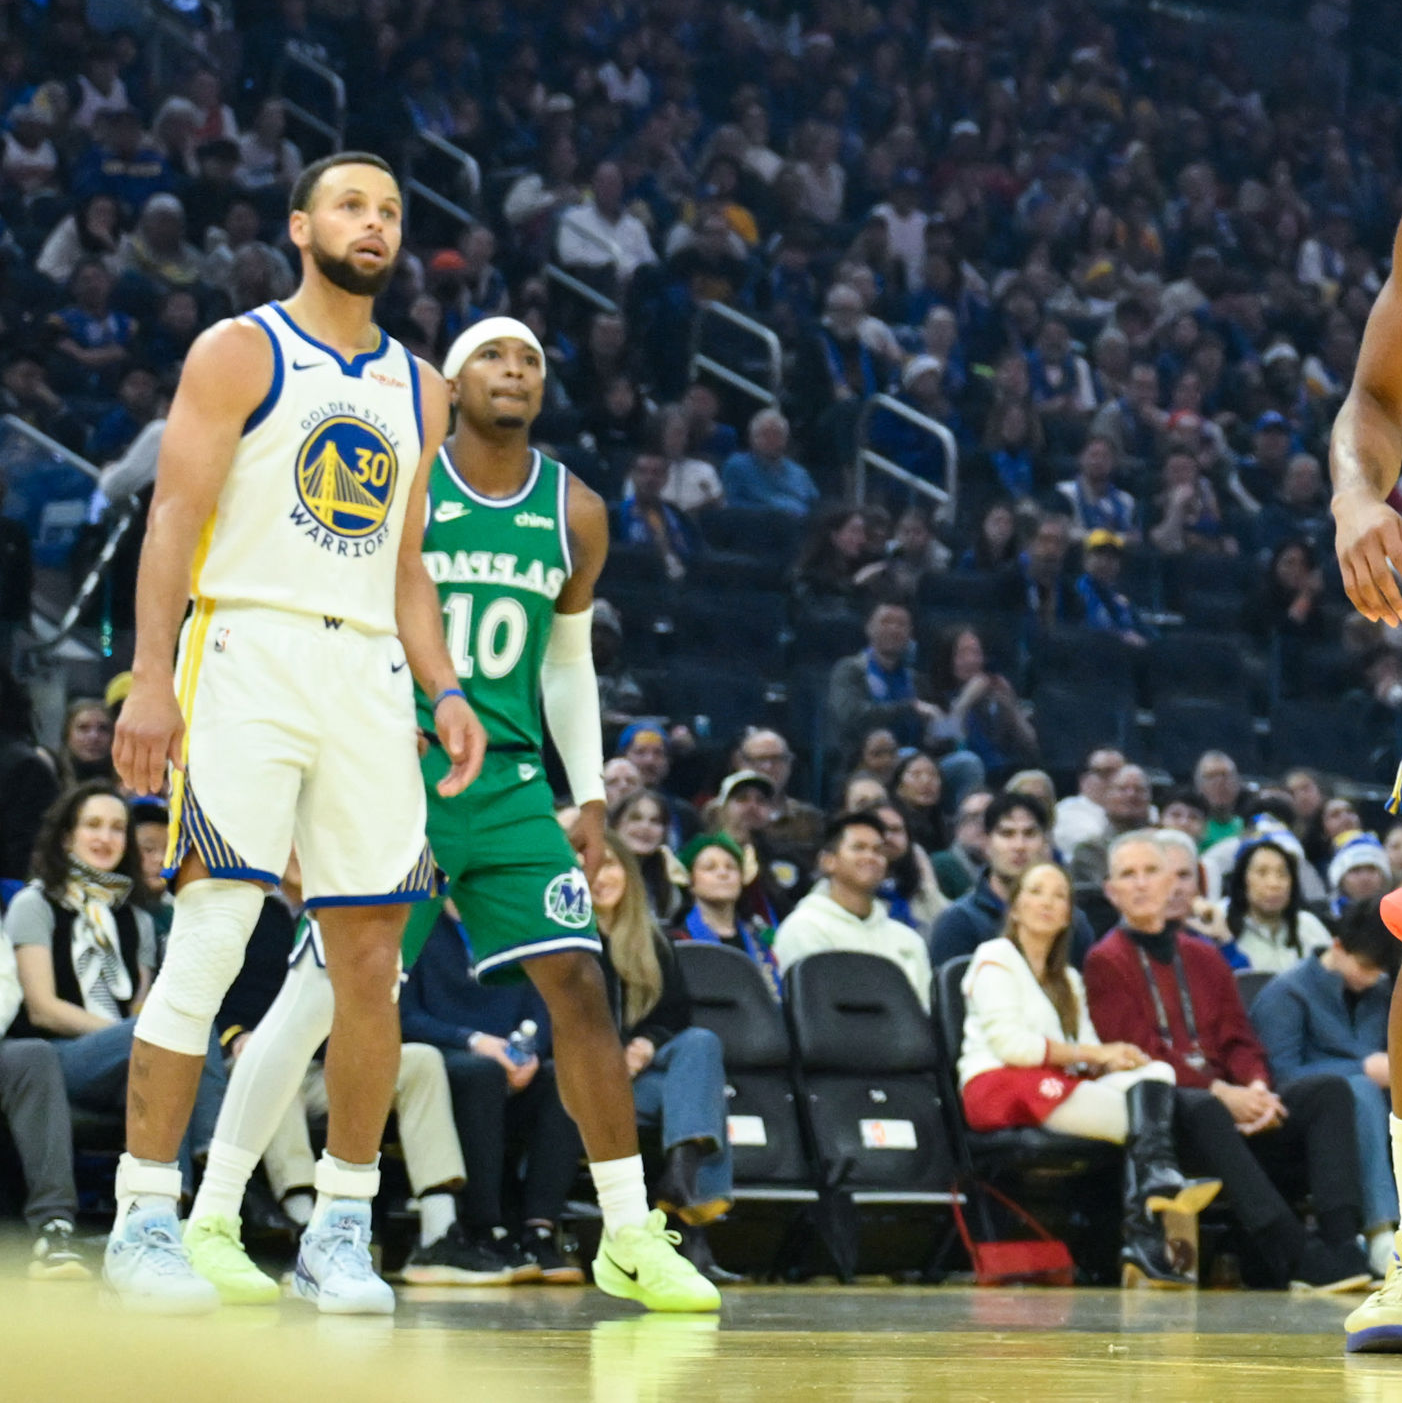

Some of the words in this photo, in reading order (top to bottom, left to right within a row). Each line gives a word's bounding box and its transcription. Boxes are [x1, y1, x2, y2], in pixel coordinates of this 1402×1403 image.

[300, 401, 357, 430] GOLDEN
[364, 409, 400, 448] STATE
[353, 447, 389, 488] 30
[289, 502, 390, 558] WARRIORS
[513, 510, 555, 531] chime
[421, 549, 567, 601] DALLAS
[442, 591, 529, 680] 10
